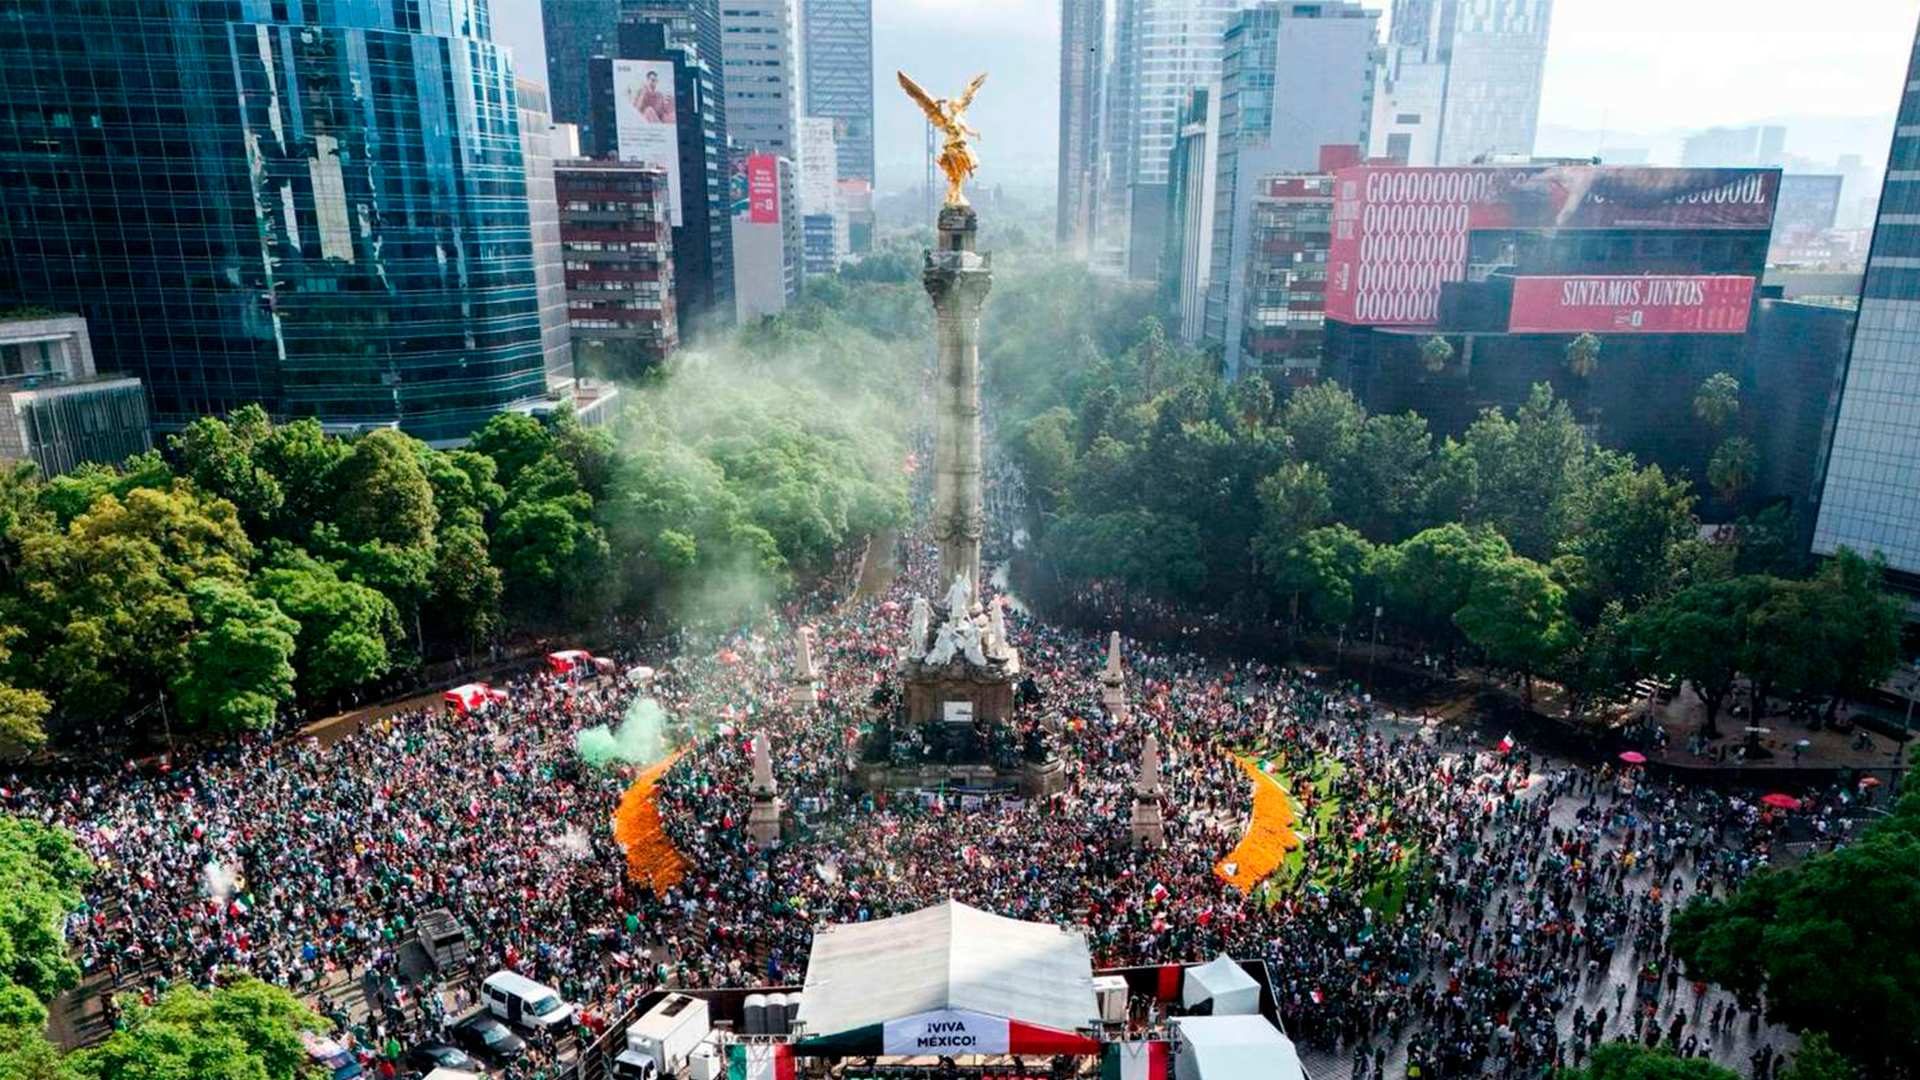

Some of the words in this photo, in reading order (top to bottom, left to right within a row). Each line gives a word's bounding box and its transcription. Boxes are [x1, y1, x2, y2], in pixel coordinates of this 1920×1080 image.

[1561, 280, 1642, 307] SINTAMOS
[1643, 280, 1706, 306] JUNTOS
[928, 1021, 965, 1033] ¡VIVA
[917, 1035, 976, 1048] MÉXICO!
